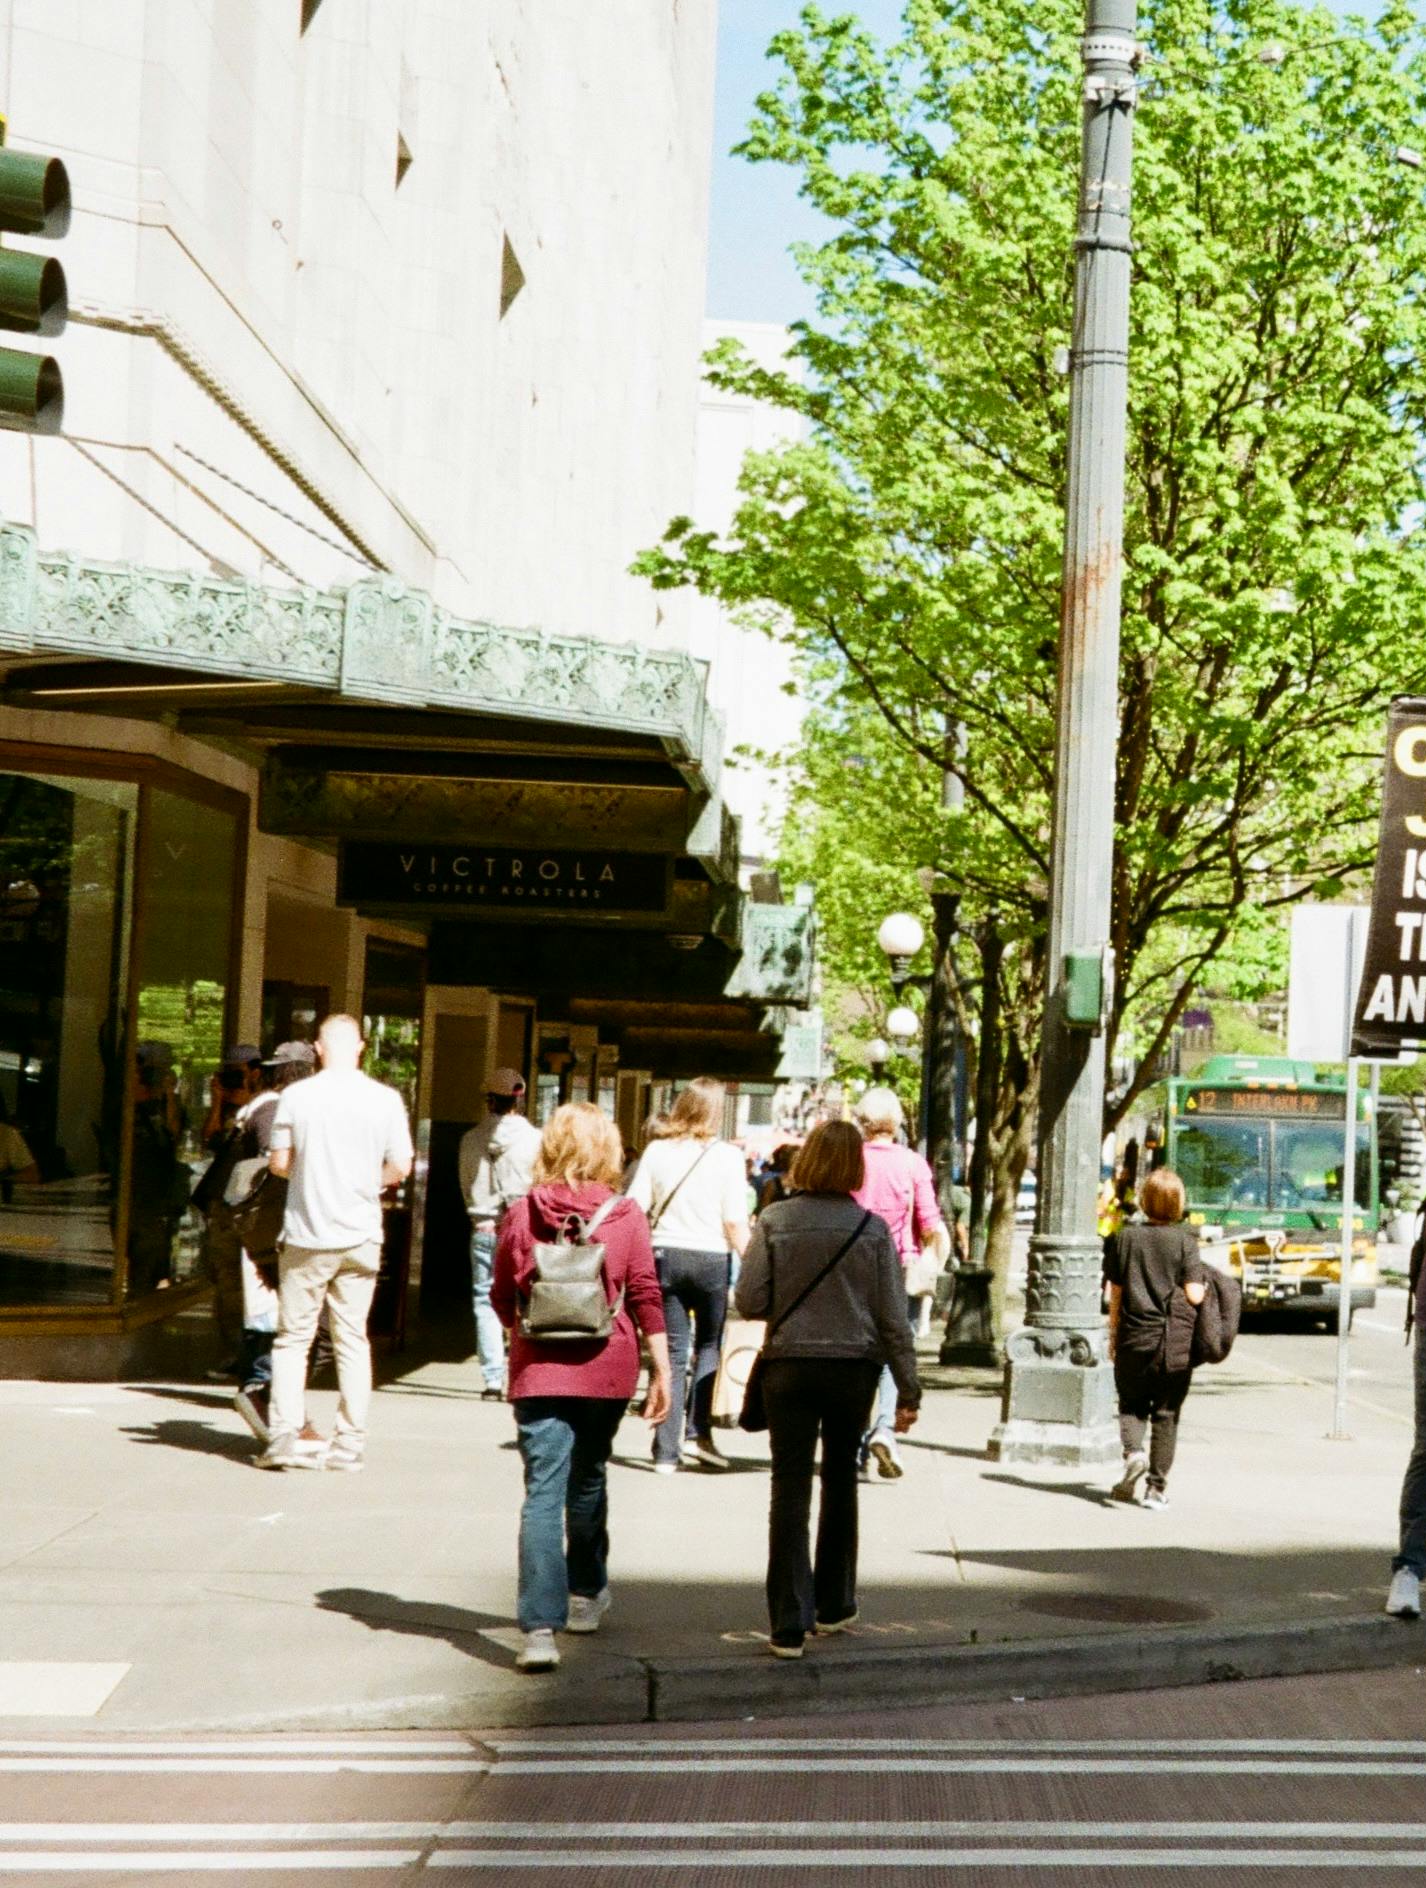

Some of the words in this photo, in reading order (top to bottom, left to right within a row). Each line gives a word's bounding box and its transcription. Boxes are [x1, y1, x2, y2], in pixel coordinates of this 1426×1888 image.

[400, 855, 615, 881] VICTROLA
[413, 882, 485, 895] COFFEE
[501, 885, 601, 898] ROASTERS
